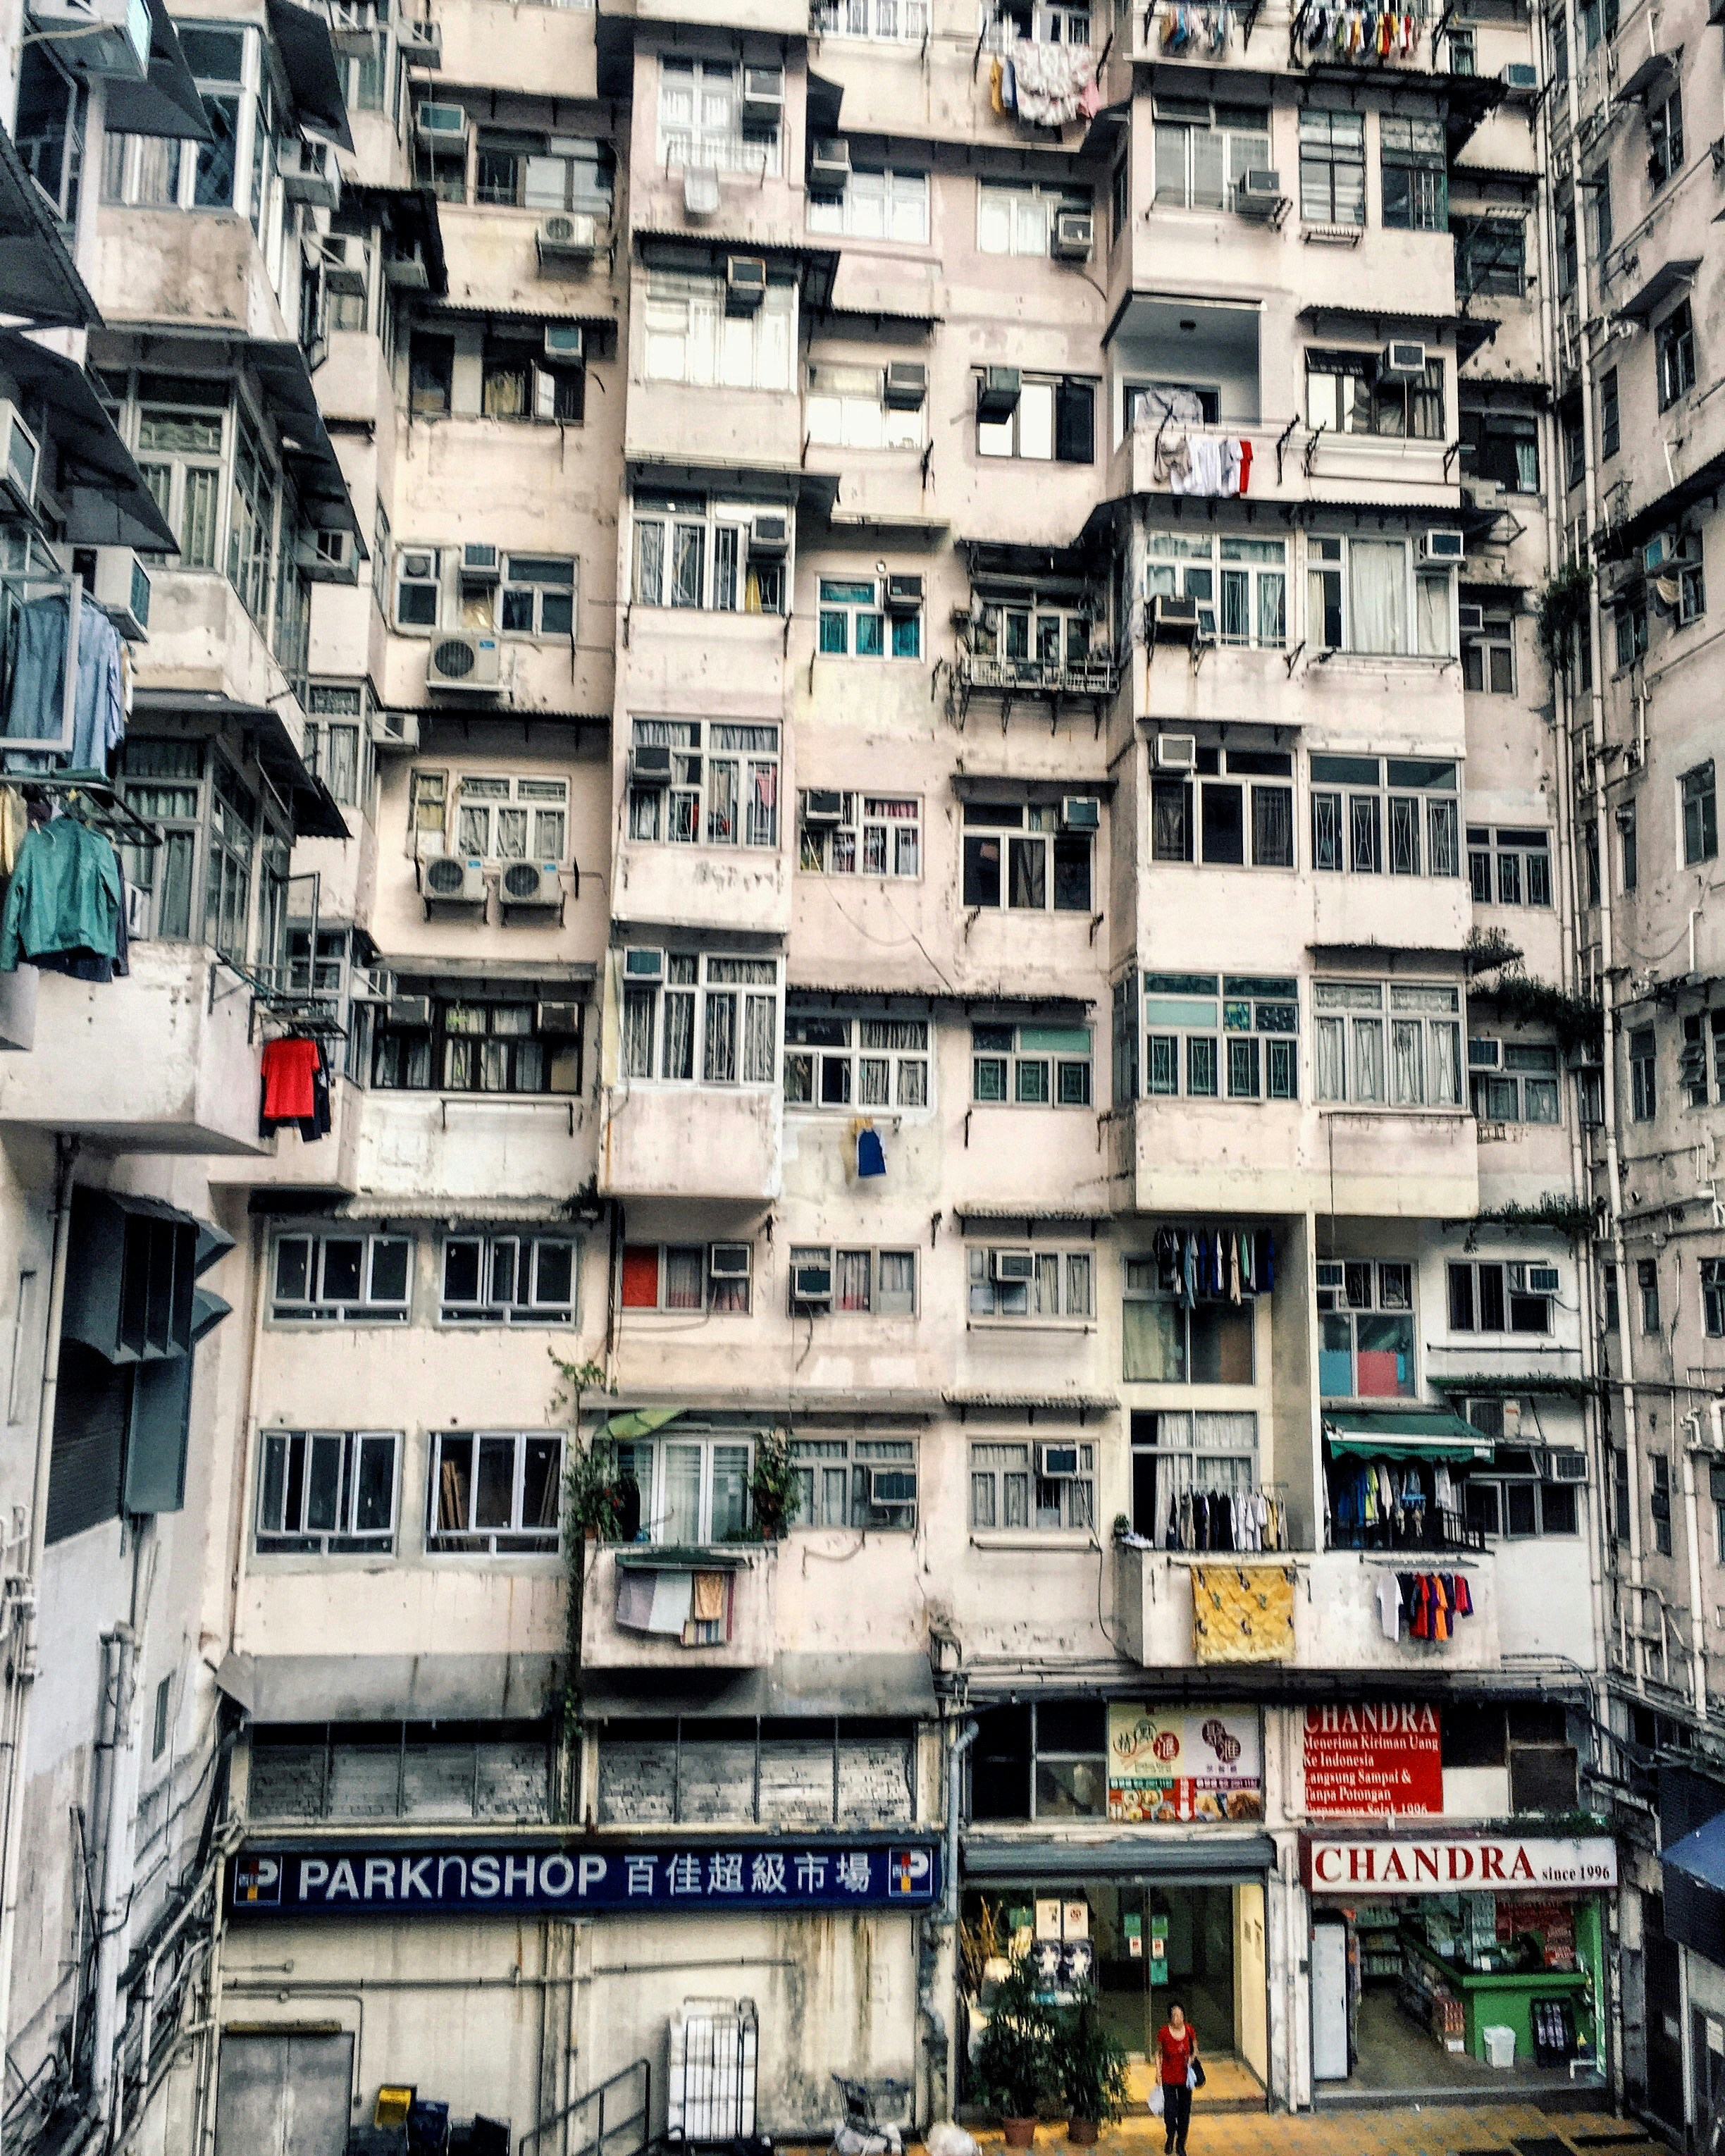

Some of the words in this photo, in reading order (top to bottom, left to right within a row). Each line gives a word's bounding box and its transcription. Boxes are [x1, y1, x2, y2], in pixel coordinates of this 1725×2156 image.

[1304, 1701, 1438, 1734] CHANDRA
[1361, 1734, 1406, 1750] Kiriman
[1409, 1734, 1439, 1752] Uang
[1320, 1751, 1374, 1767] Indonesia
[1358, 1768, 1399, 1787] Sampai
[1402, 1768, 1411, 1784] &
[1339, 1785, 1392, 1803] Potongan
[1402, 1802, 1428, 1816] 1996
[1315, 1844, 1537, 1883] CHANDRA
[1541, 1866, 1576, 1881] since
[1580, 1864, 1610, 1881] 1996
[298, 1854, 607, 1901] PARKnSHOP
[624, 1851, 872, 1896] 百佳超級市場
